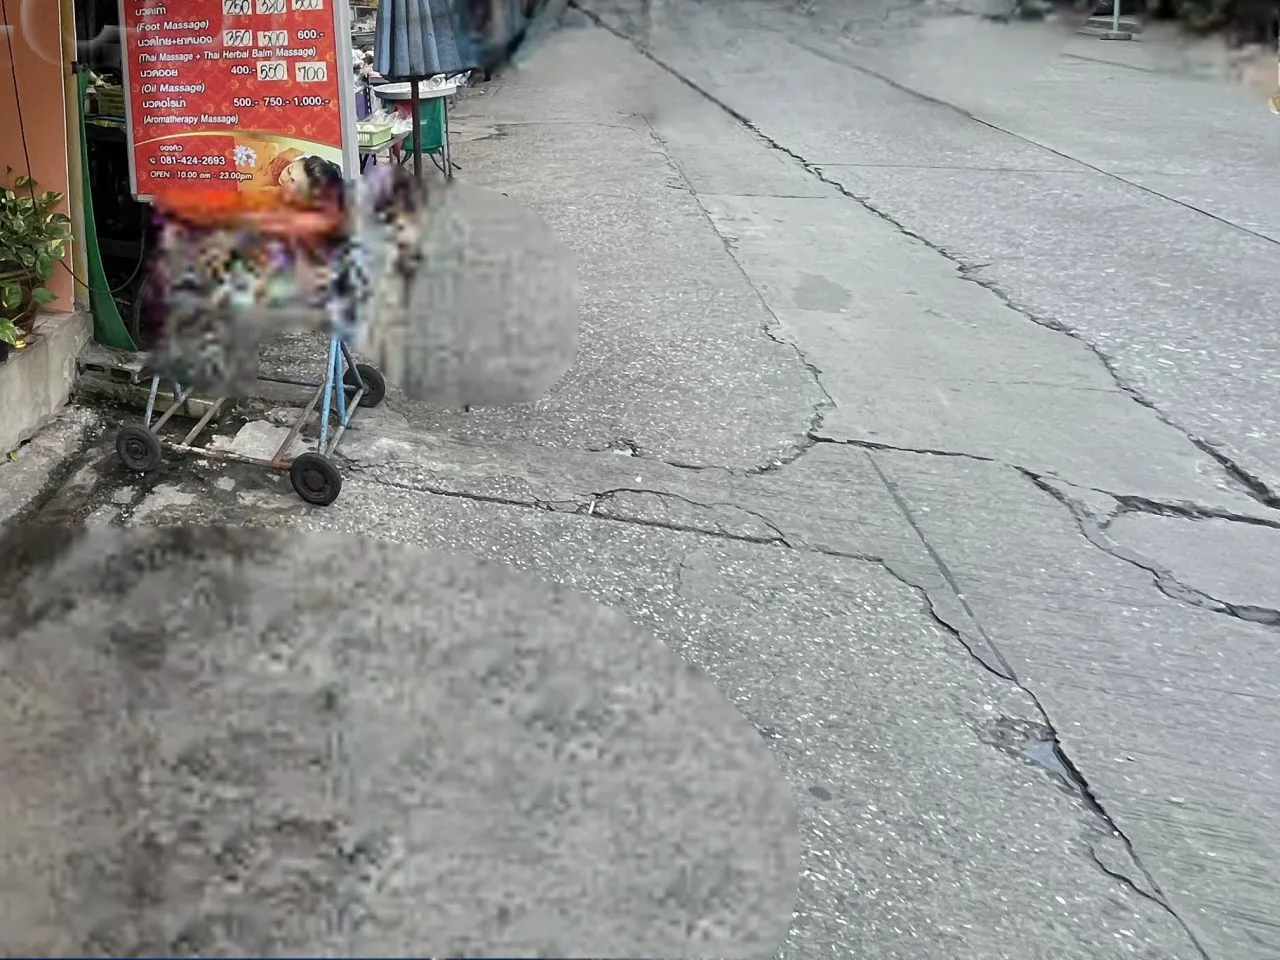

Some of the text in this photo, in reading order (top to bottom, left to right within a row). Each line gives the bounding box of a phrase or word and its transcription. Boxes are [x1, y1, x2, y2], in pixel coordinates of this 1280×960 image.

[136, 19, 209, 33] (Foot Massage)
[225, 30, 251, 47] 350
[297, 30, 324, 40] 600.-
[139, 53, 157, 63] (Thai
[159, 52, 194, 62] Massage
[203, 50, 220, 59] Thai
[222, 50, 249, 59] Herbal
[252, 48, 273, 58] Balm
[275, 46, 317, 58] Massage)
[230, 63, 325, 81] 400.- 550 700
[141, 82, 205, 94] (Oil Massage)
[233, 97, 258, 107] 500.-
[263, 97, 290, 107] 750.-
[143, 113, 239, 125] (Aromatherapy Massage)
[160, 155, 225, 165] 081-424-2693
[219, 171, 252, 181] 23.00pm
